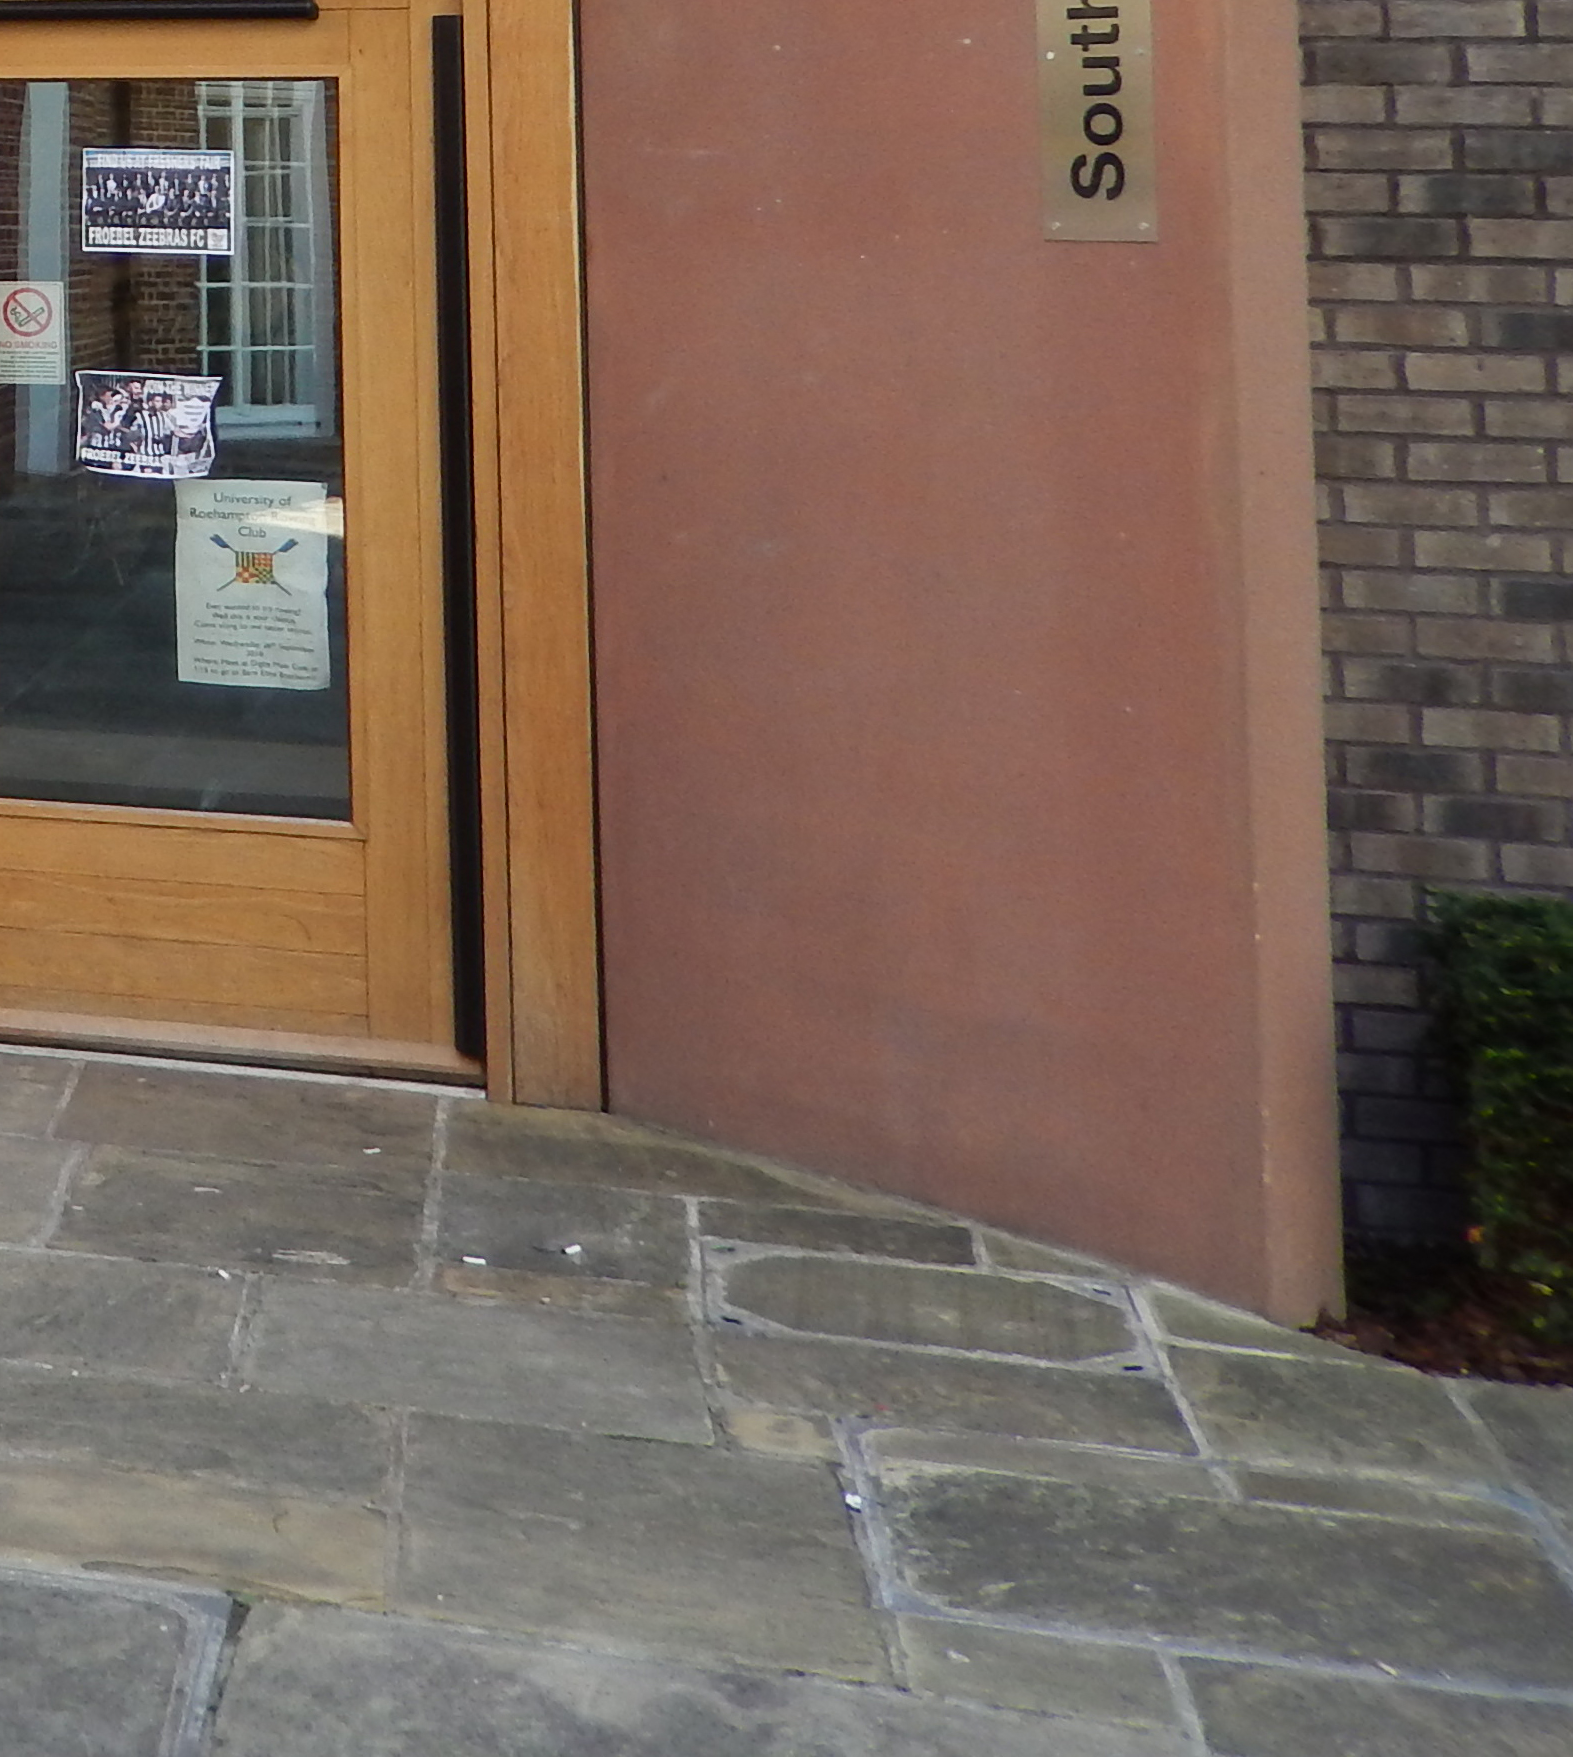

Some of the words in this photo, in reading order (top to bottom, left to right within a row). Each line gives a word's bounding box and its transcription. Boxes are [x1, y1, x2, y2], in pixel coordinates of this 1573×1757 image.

[88, 226, 137, 245] FROEBEL
[138, 227, 188, 246] ZEEBRAS
[190, 228, 205, 247] FC
[14, 340, 58, 349] SMOKING
[213, 491, 274, 508] University
[278, 496, 292, 506] of
[238, 526, 267, 538] Club
